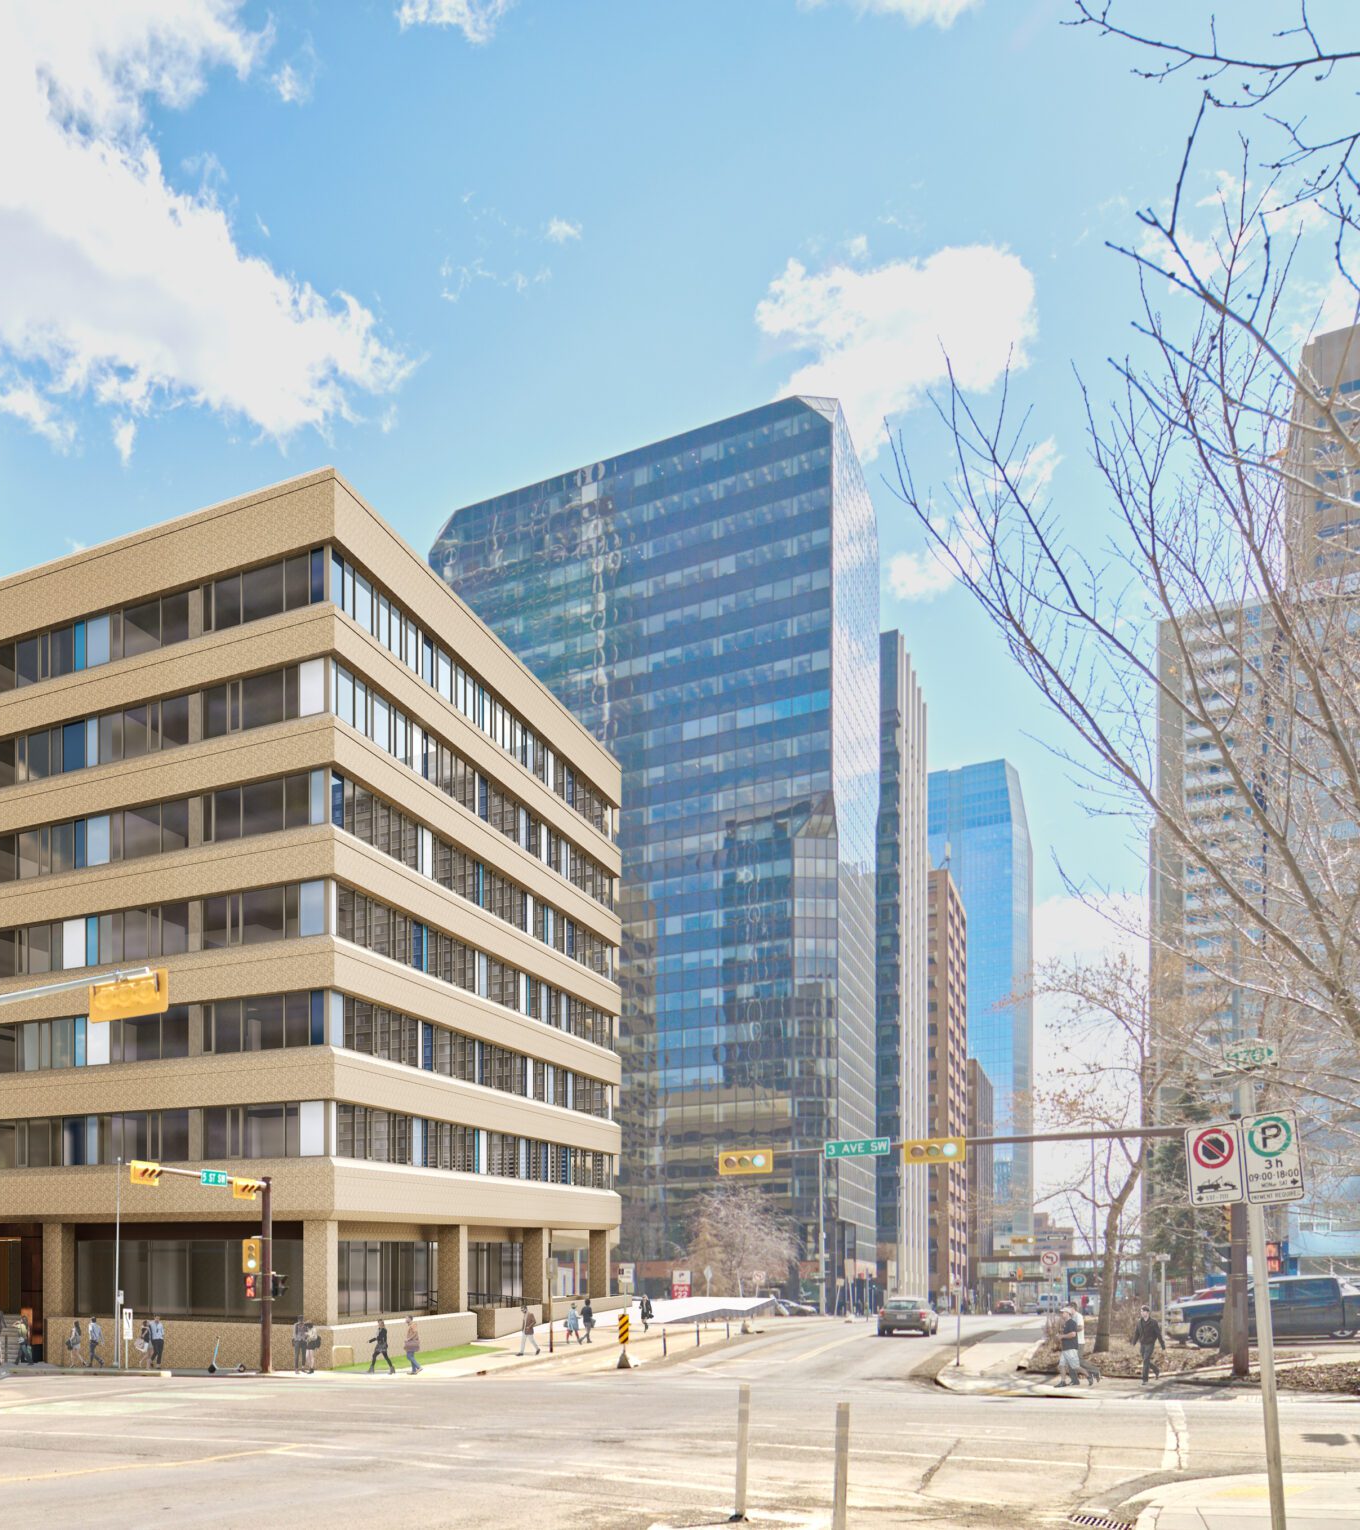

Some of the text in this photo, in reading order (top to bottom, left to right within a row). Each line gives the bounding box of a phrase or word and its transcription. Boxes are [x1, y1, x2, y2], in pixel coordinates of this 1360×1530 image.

[1261, 1123, 1282, 1149] P
[828, 1140, 888, 1155] 3 AVE SW
[1264, 1158, 1283, 1170] 3 h
[208, 1173, 216, 1183] ST
[217, 1174, 226, 1183] SW
